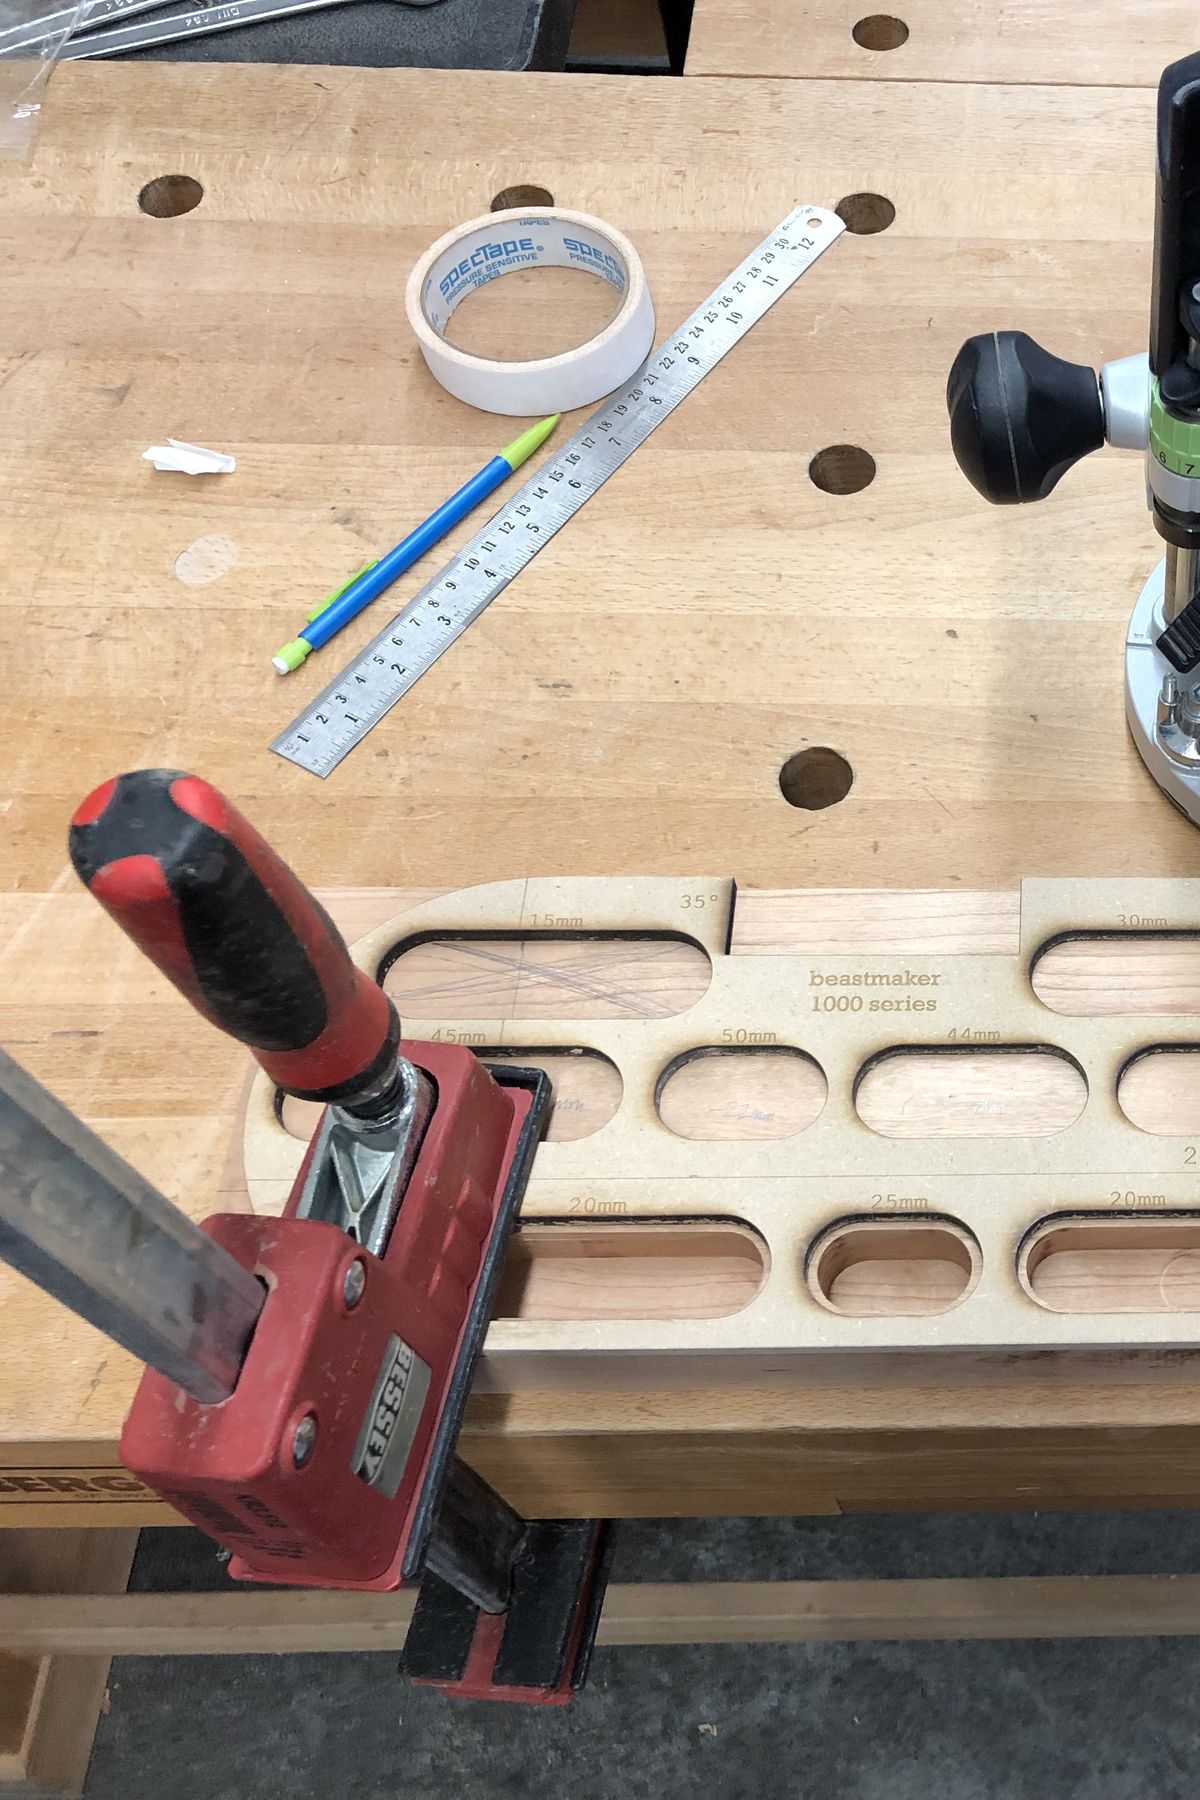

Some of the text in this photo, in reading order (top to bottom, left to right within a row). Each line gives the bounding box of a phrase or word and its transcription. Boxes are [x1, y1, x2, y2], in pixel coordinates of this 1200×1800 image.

[485, 252, 538, 272] SENSITIVE
[1160, 452, 1167, 464] 6
[1185, 464, 1195, 474] 7
[345, 237, 815, 723] 1 2 3 4 5 6 7 8 9 10 11 12
[297, 238, 789, 743] 1 2 3 4 5 6 7 8 9 10 11 12 13 14 15 16 17 18 19 20 21 22 23 24 25 26 27 28 29 30
[680, 894, 719, 909] 35°
[530, 914, 583, 928] 15mm
[1117, 914, 1168, 927] 30mm
[809, 970, 941, 987] beastmaker
[811, 996, 937, 1012] 1000 series
[431, 1028, 486, 1043] 45mm
[722, 1029, 776, 1043] 50mm
[947, 1027, 1000, 1041] 44mm
[568, 1197, 628, 1213] 20mm
[871, 1193, 929, 1210] 25mm
[1110, 1191, 1167, 1206] 20mm
[364, 1338, 414, 1480] BESSEY
